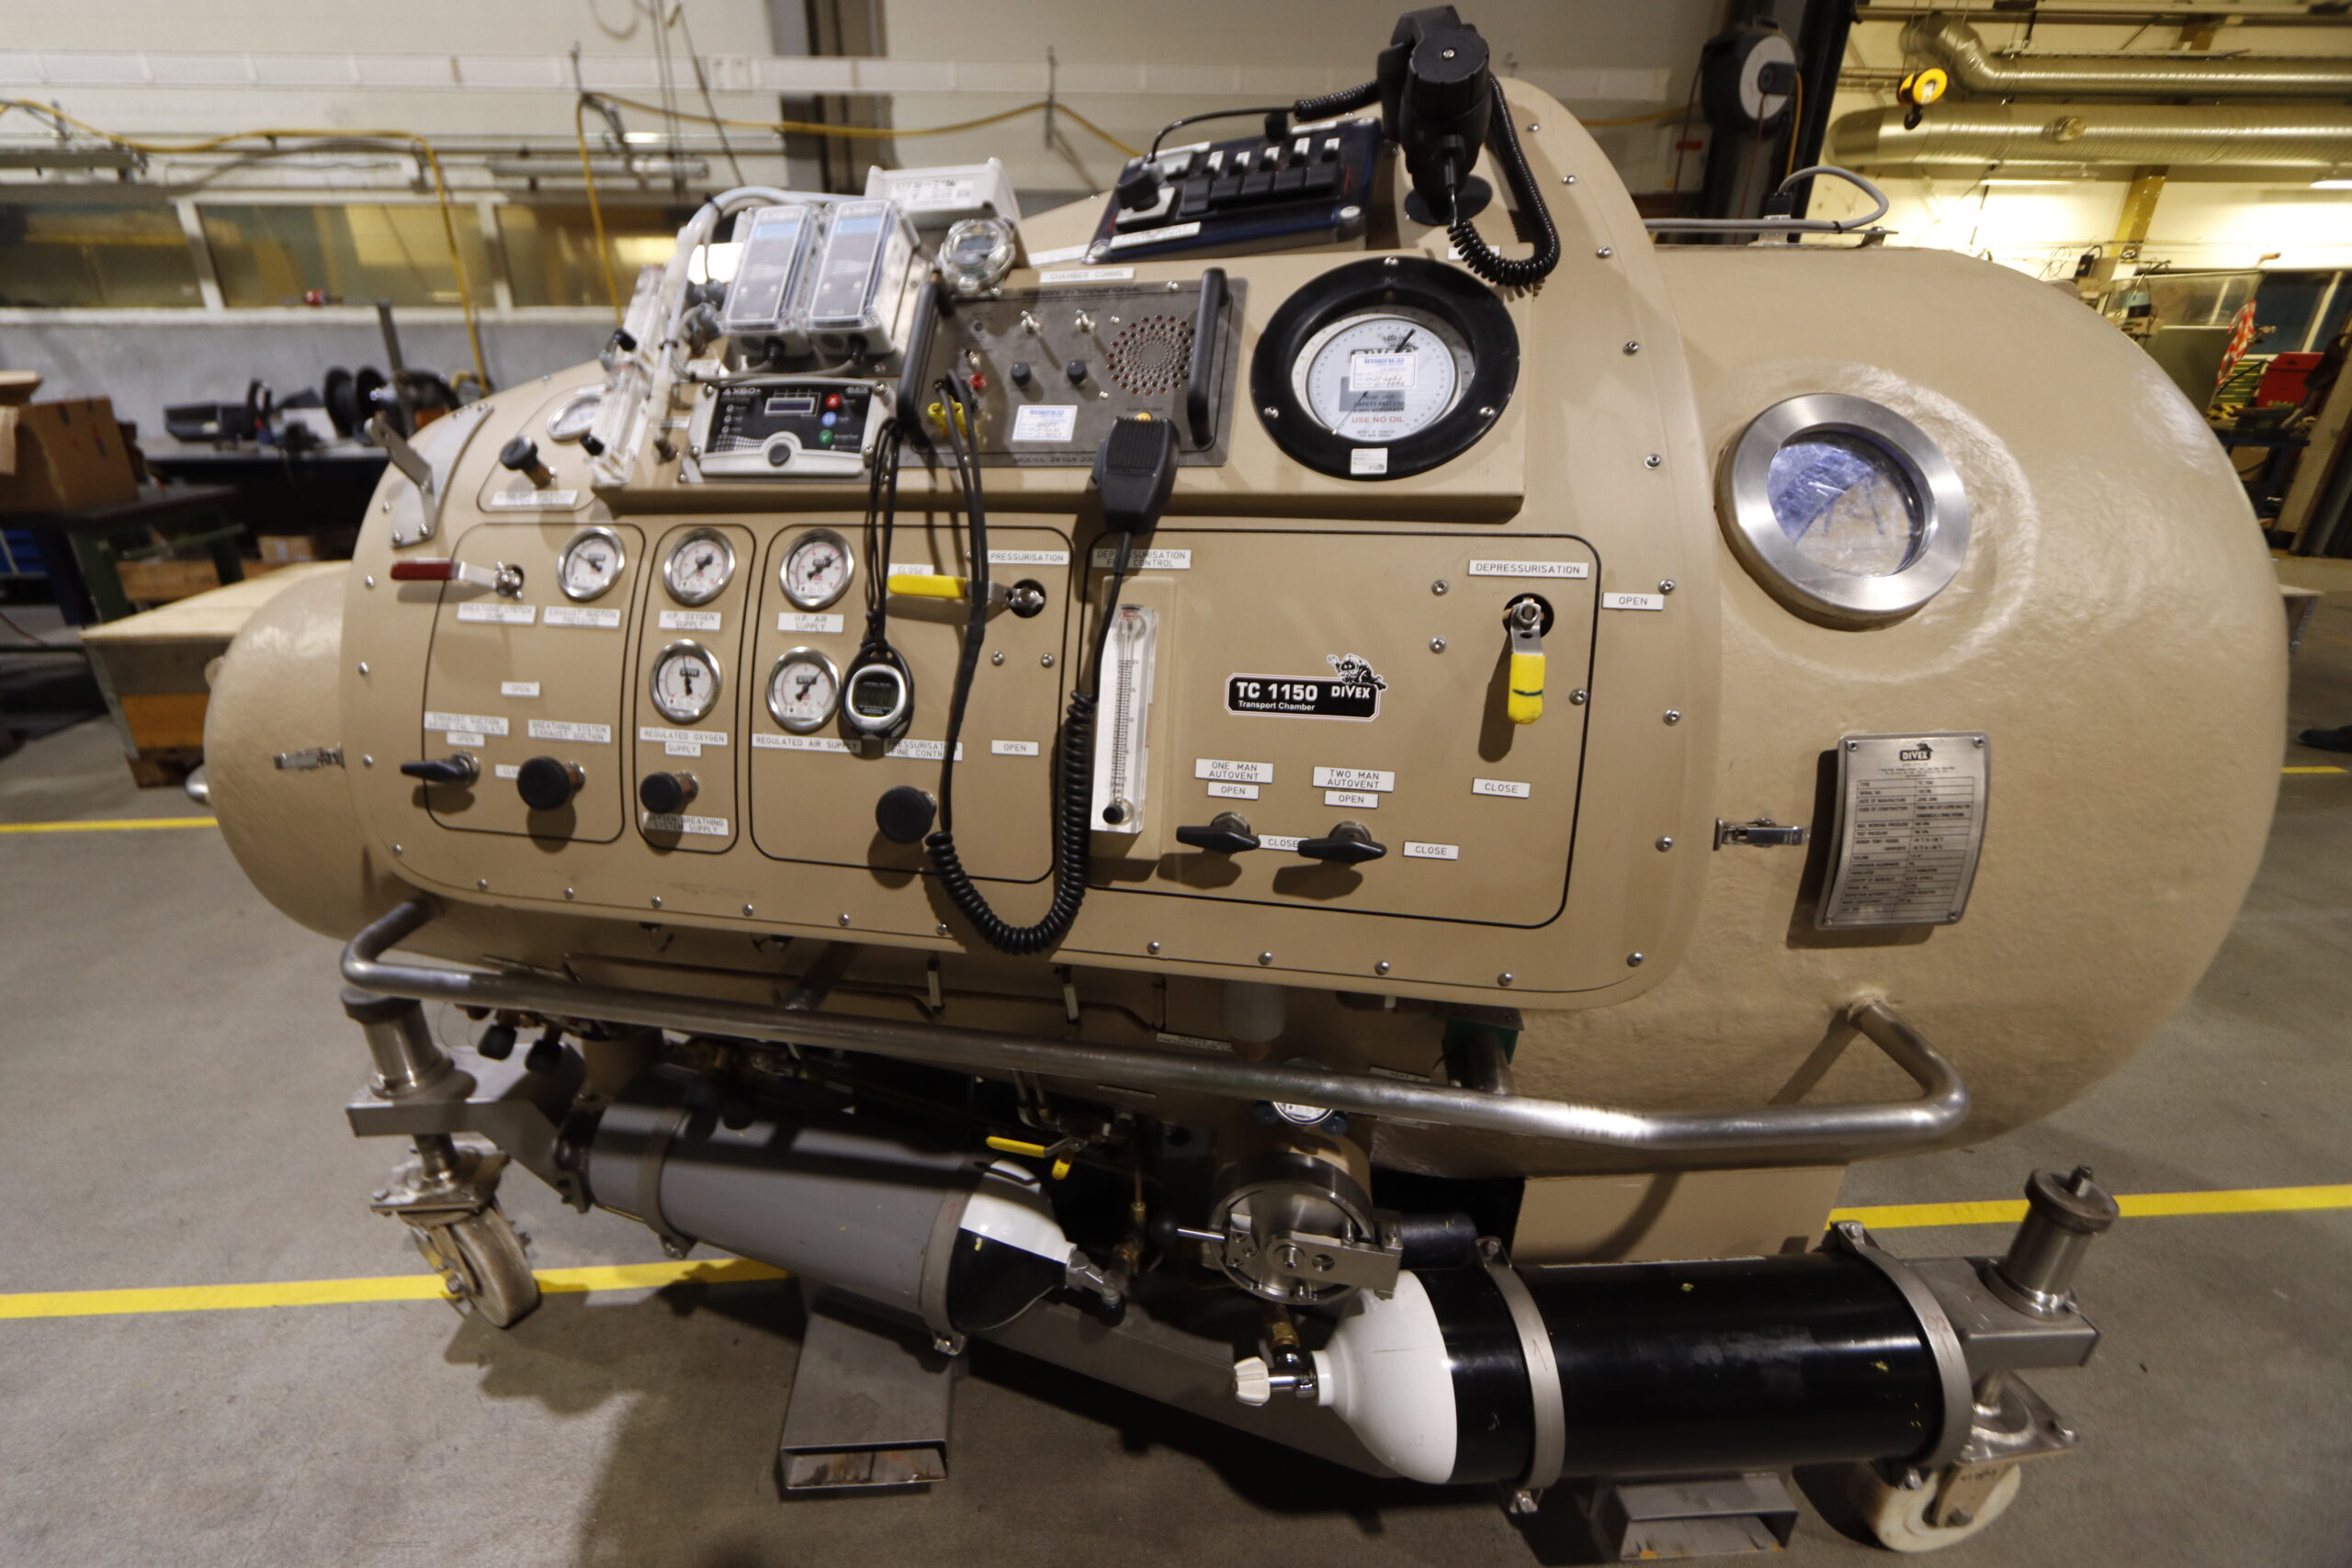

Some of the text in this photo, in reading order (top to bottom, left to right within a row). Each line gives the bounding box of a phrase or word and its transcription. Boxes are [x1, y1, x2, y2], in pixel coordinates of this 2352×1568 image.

[1050, 272, 1089, 280] CHAMBER
[989, 553, 1064, 562] PRESSURISATION
[1097, 550, 1186, 559] DEPSURISATION
[1133, 558, 1174, 568] CONTROL
[898, 566, 925, 575] CLOSE
[1476, 563, 1580, 574] DEPRESSURISATION
[1619, 595, 1648, 606] OPEN
[684, 614, 716, 622] OXYGEN
[814, 614, 828, 623] AIR
[675, 620, 705, 628] SUPPLY
[795, 623, 826, 631] SUPPLY
[1237, 682, 1371, 701] TC 1150 DIVEX
[1238, 700, 1316, 711] Transport Chamber
[532, 722, 607, 734] BREATHING SYSTEM
[534, 729, 605, 741] EXHAUST SUCTION
[644, 730, 725, 742] REGULATED OXYGEN
[756, 738, 858, 750] REGULATED AIR SUPPLY
[1003, 743, 1026, 751] OPEN
[668, 745, 697, 754] SUPPLY
[915, 749, 943, 758] CONTR
[1902, 750, 1928, 761] DIVEX
[1212, 761, 1258, 772] ONE MAN
[1208, 770, 1259, 781] AUTOVENT
[1329, 769, 1380, 781] TWO MAN
[1327, 779, 1380, 789] AUTOVENT
[1485, 783, 1519, 794] CLOSE
[1221, 785, 1246, 795] OPEN
[1338, 795, 1364, 804] OPEN
[682, 816, 724, 827] BREATHING
[688, 825, 718, 834] SUPPLY
[1269, 838, 1298, 848] CLOSE
[1415, 845, 1447, 856] CLOSE
